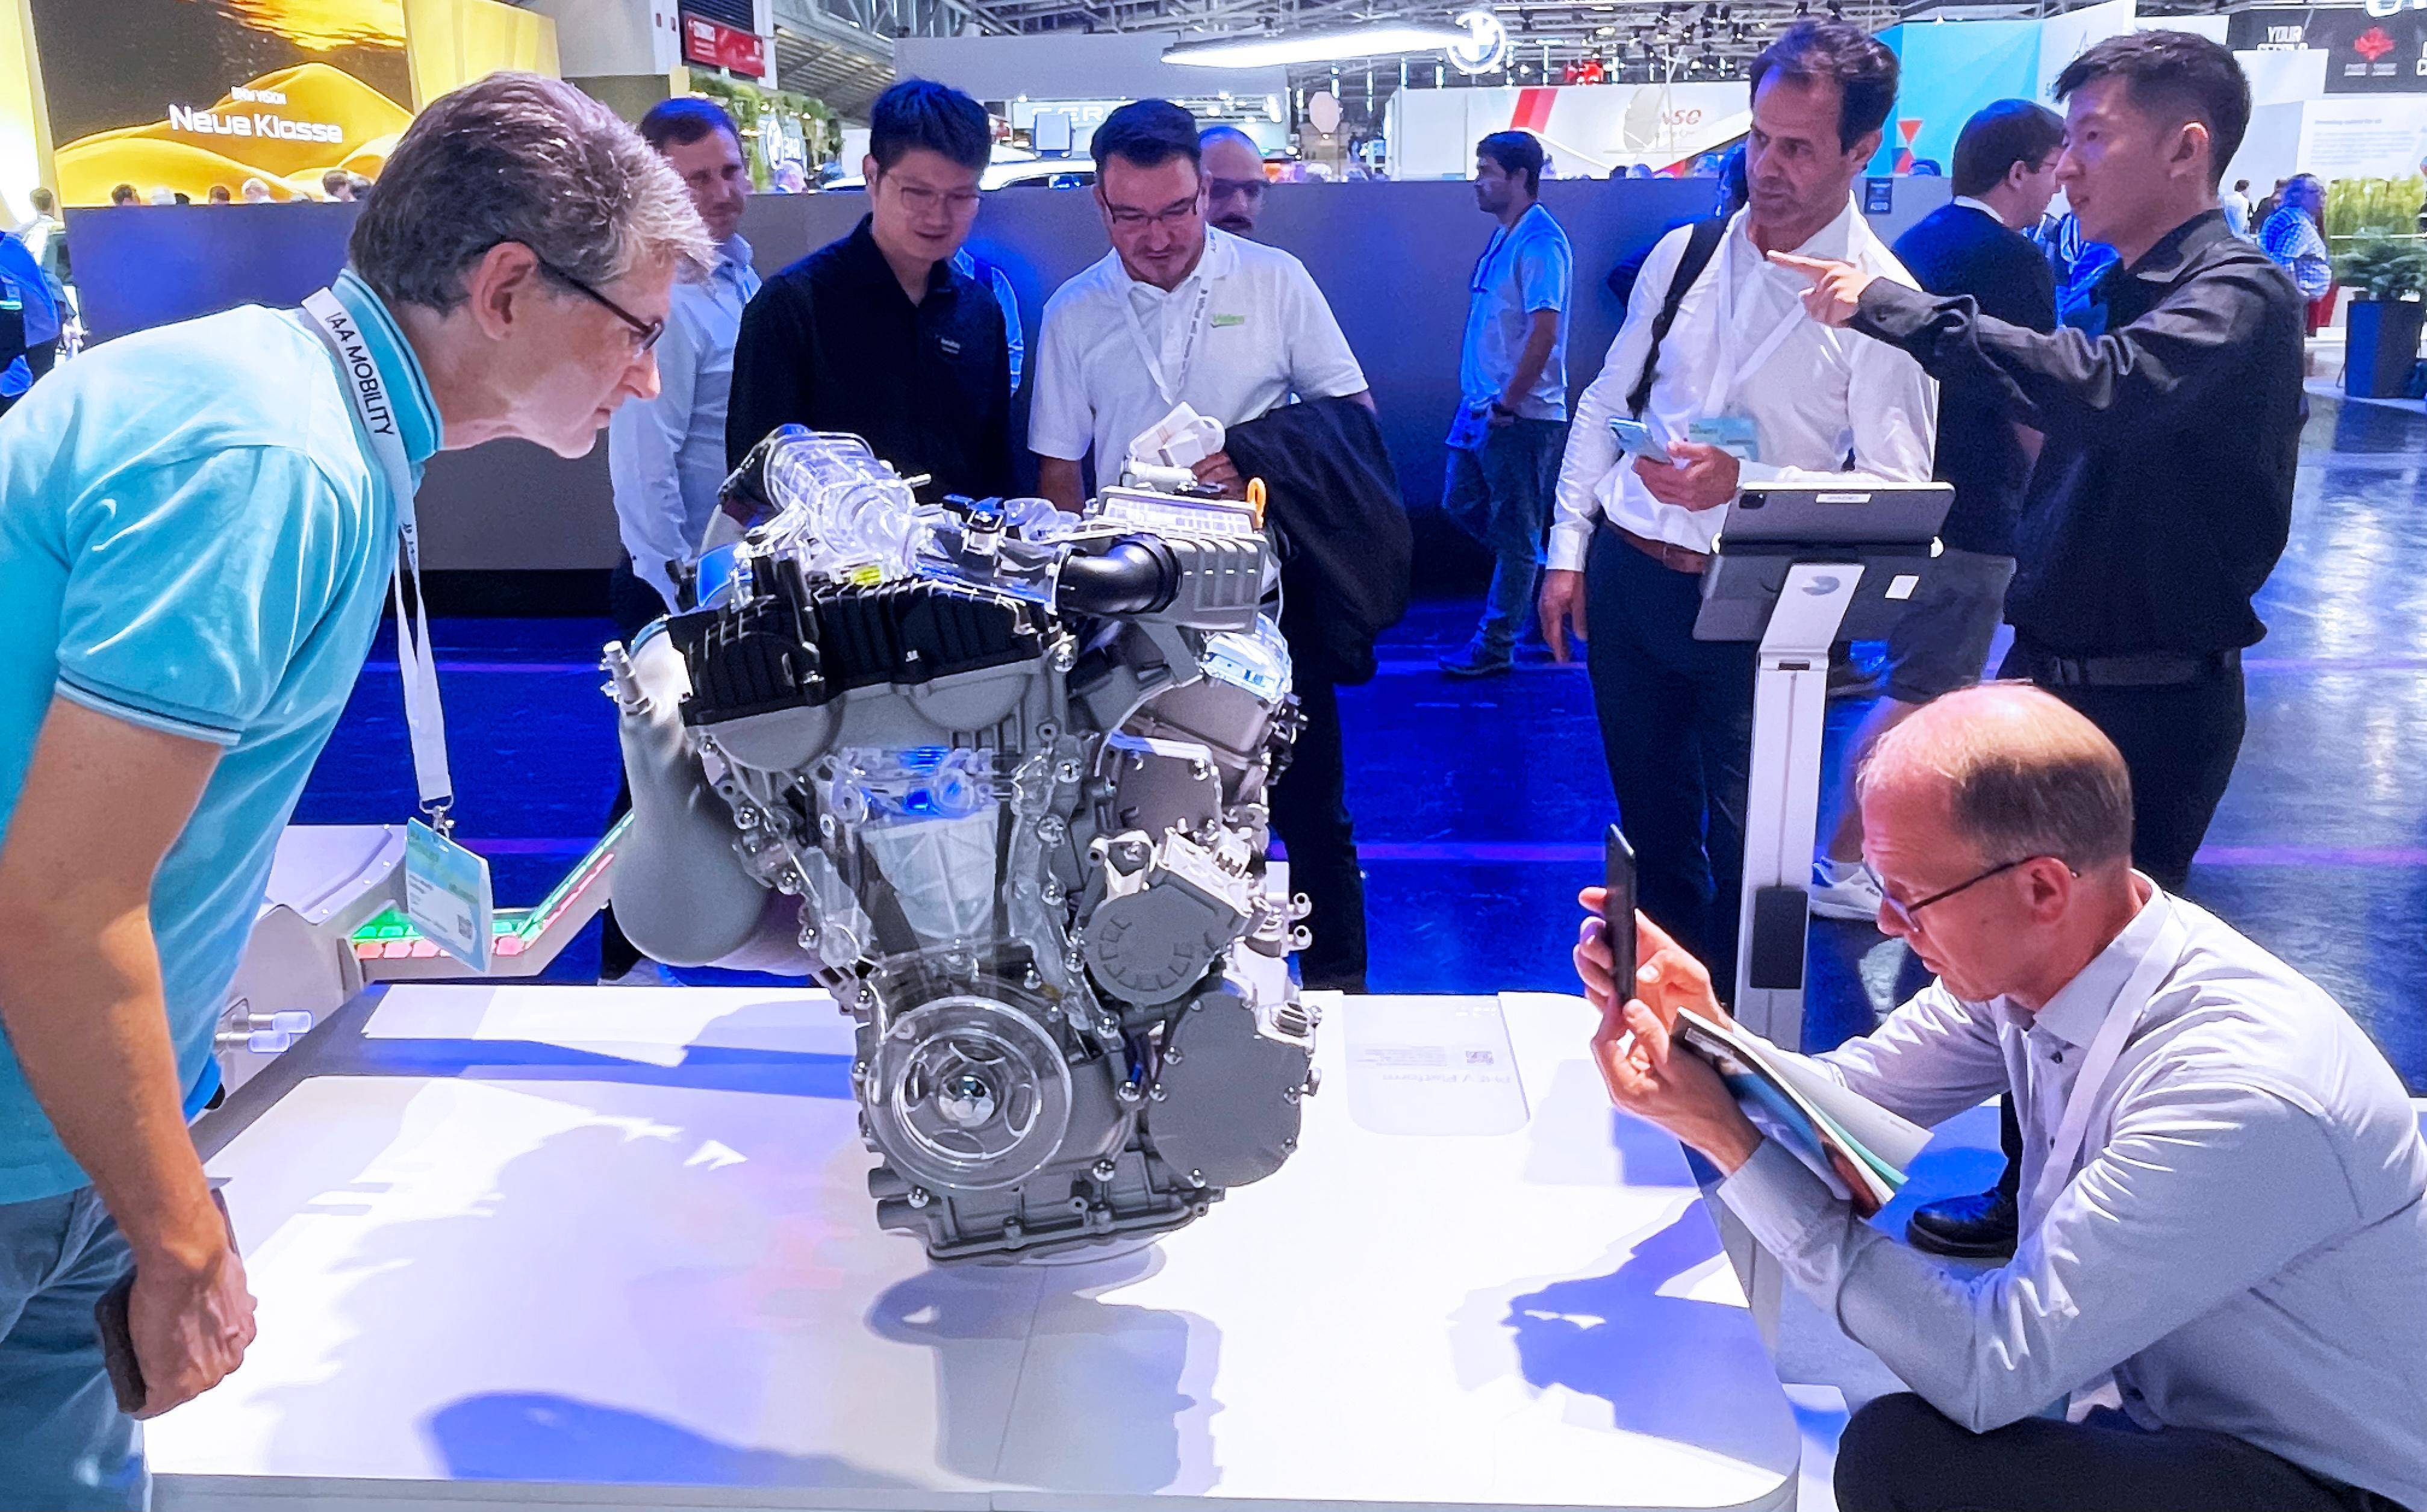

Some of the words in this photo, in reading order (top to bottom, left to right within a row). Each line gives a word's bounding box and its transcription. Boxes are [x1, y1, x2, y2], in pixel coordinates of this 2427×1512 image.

[2267, 26, 2302, 42] YOUR
[169, 104, 252, 136] Neue
[325, 312, 356, 343] IAA
[346, 346, 395, 435] MOBILITY
